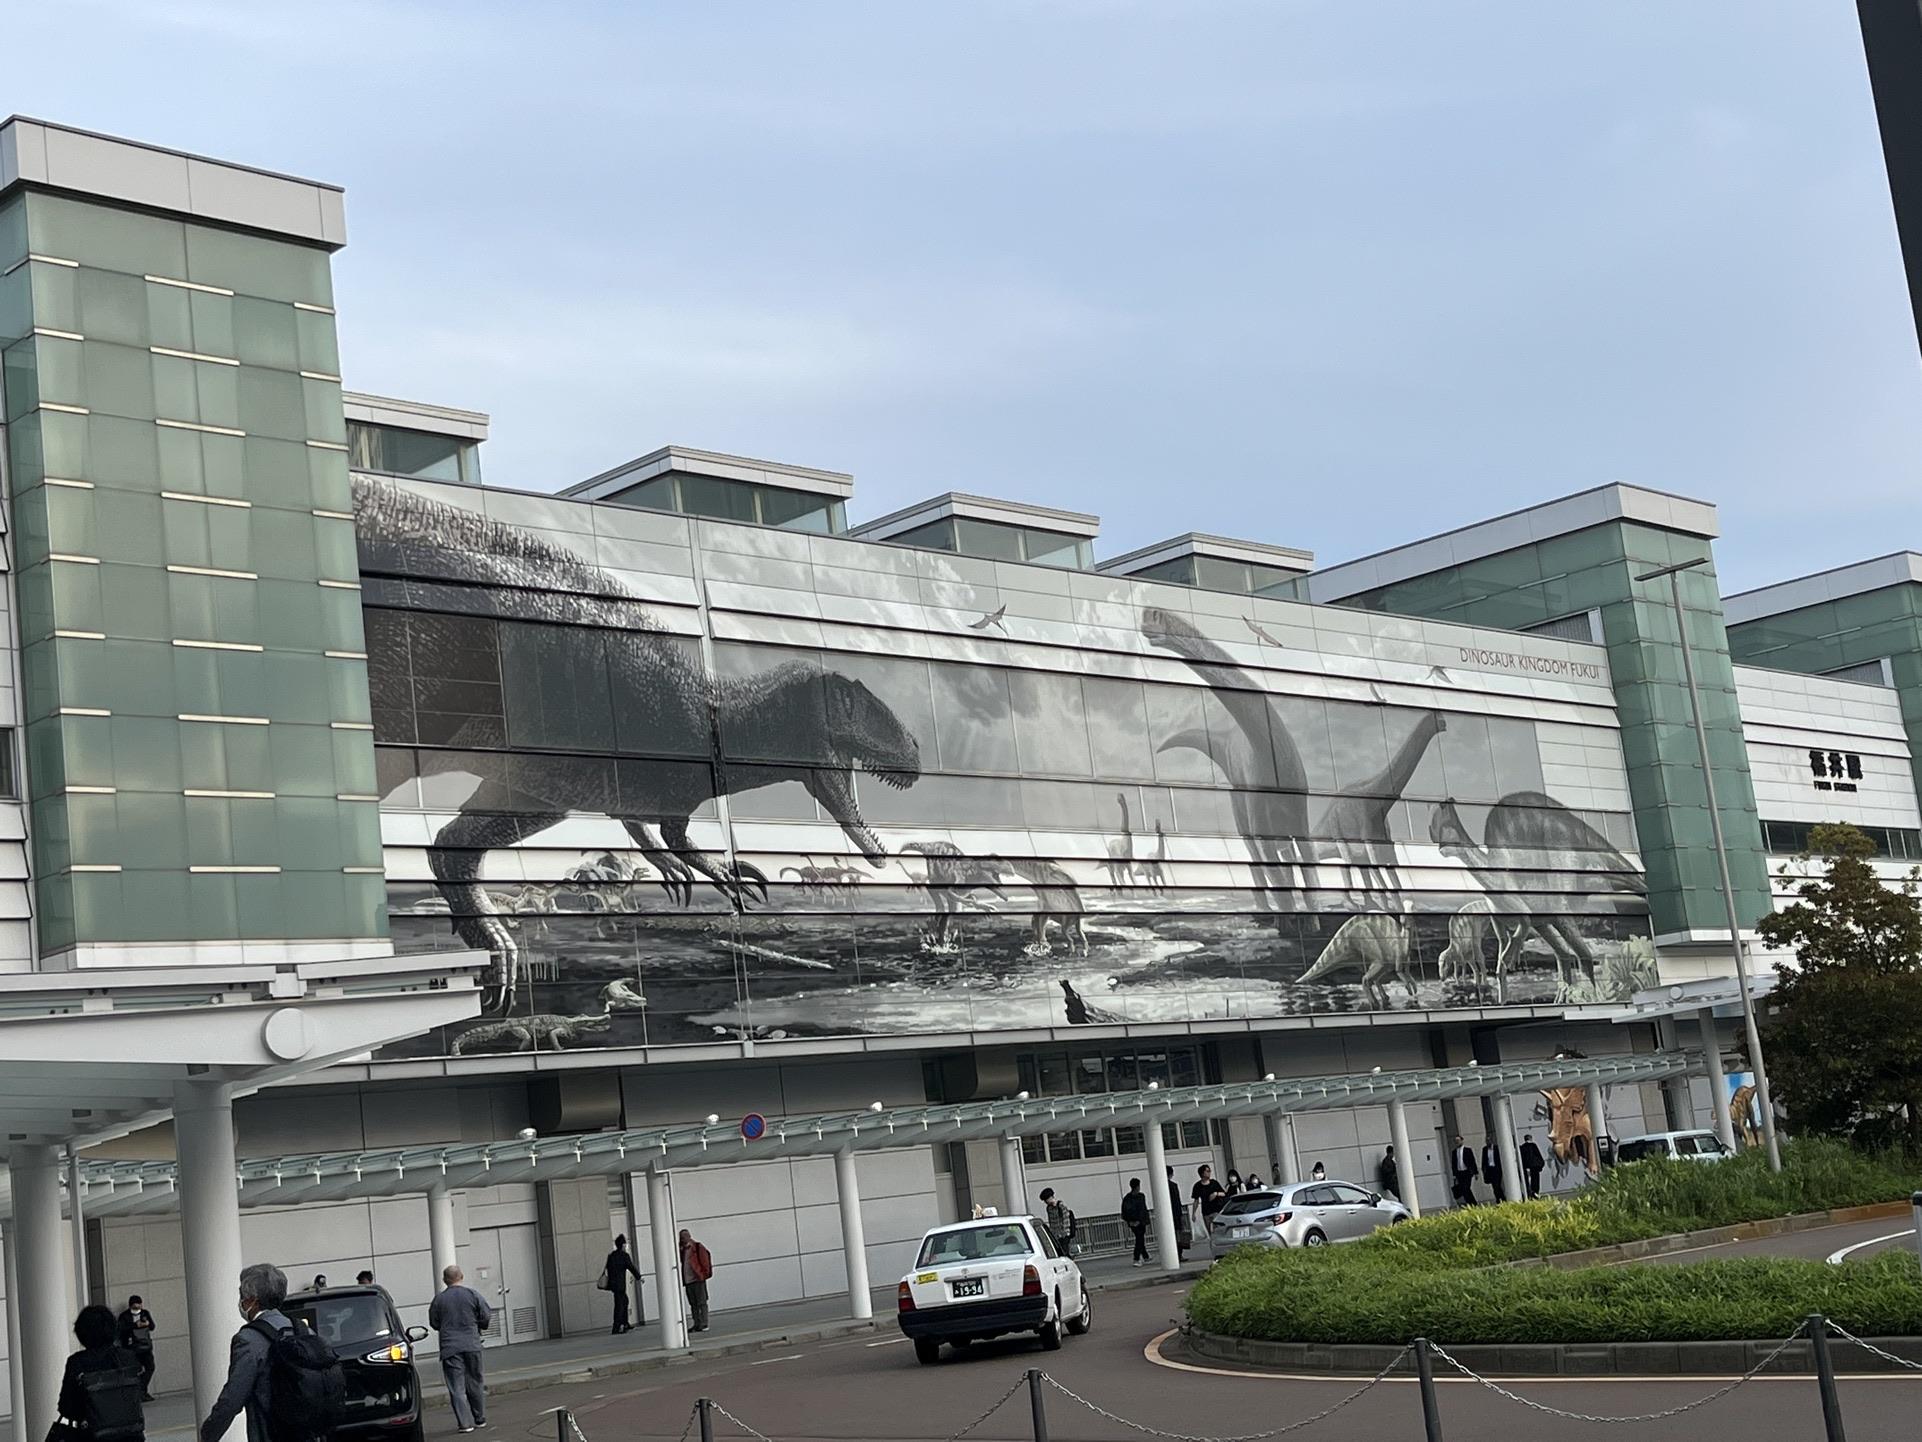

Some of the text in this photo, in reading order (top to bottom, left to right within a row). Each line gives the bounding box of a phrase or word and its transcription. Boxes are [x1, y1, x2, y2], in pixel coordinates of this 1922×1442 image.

[1460, 648, 1600, 679] DINOSAUR KINGDOM FUKUI
